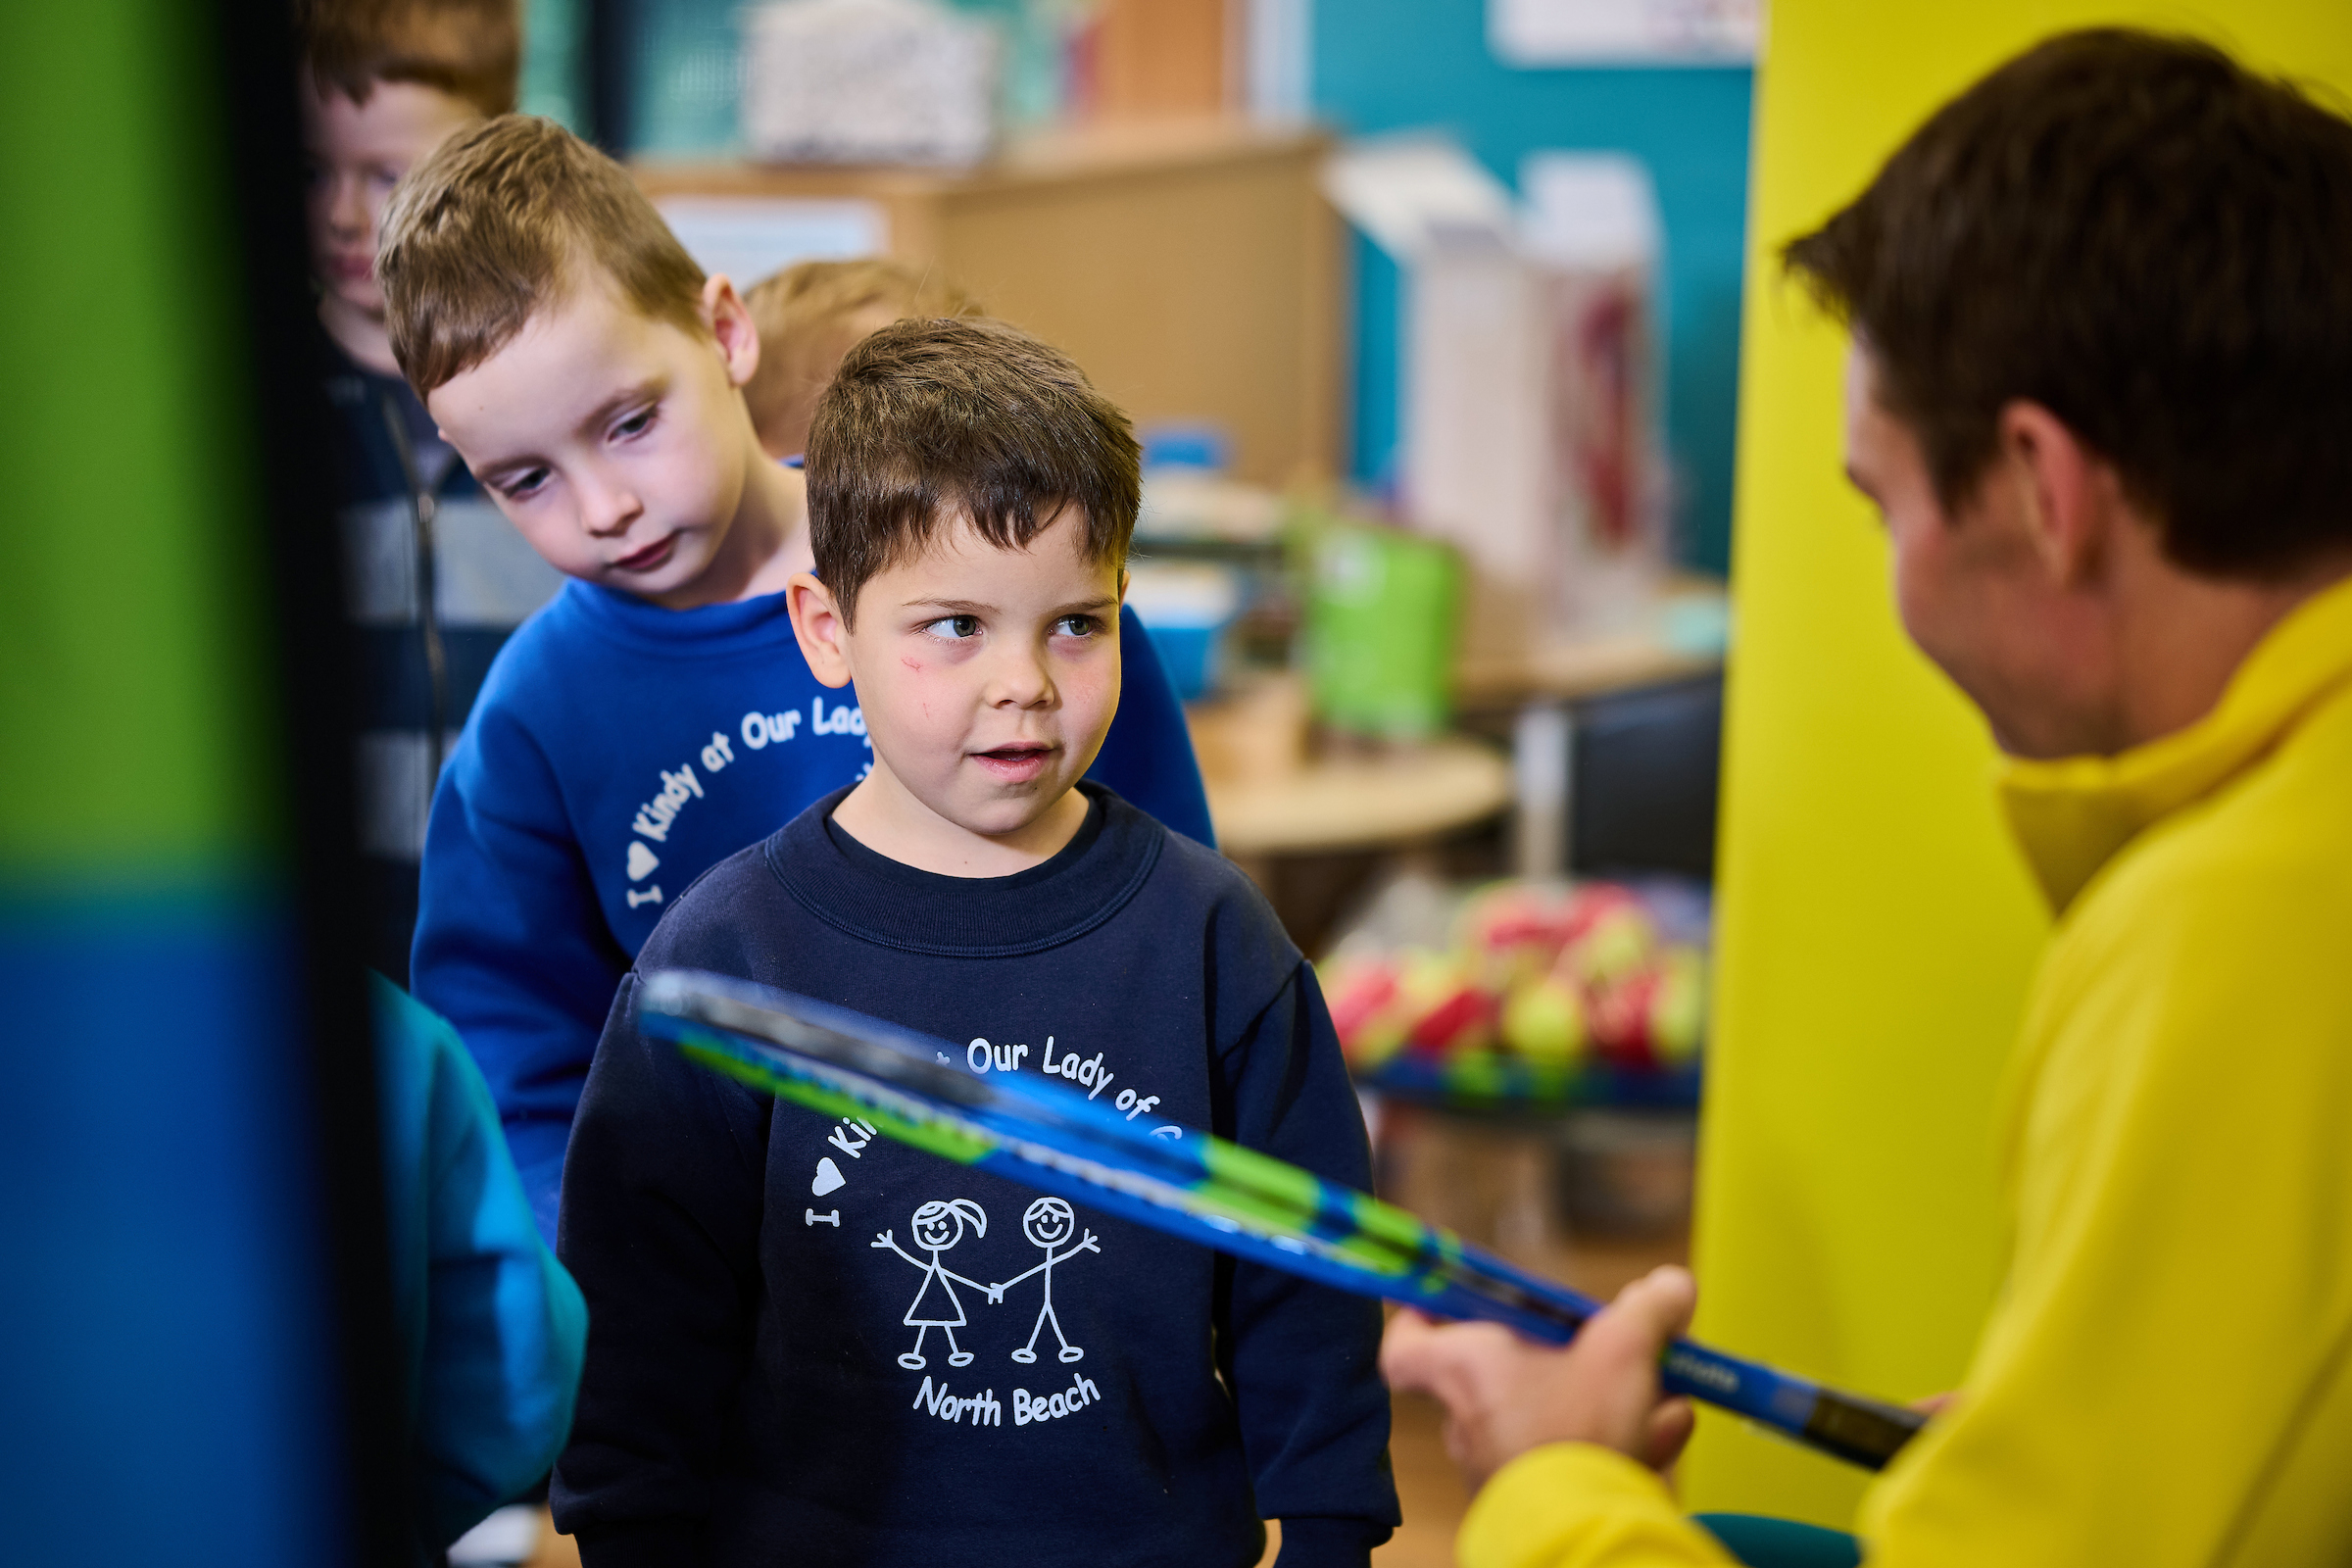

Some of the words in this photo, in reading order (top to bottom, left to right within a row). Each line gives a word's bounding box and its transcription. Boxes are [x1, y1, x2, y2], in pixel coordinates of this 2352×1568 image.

[742, 710, 801, 750] Our
[812, 695, 871, 748] Lad
[701, 731, 734, 772] at
[632, 763, 704, 842] Kindy
[628, 886, 662, 908] I
[806, 1208, 840, 1227] I
[967, 1038, 1028, 1074] Our
[1043, 1036, 1113, 1100] Lady
[1115, 1089, 1160, 1121] of
[912, 1376, 1001, 1426] North
[1013, 1373, 1101, 1426] Beach
